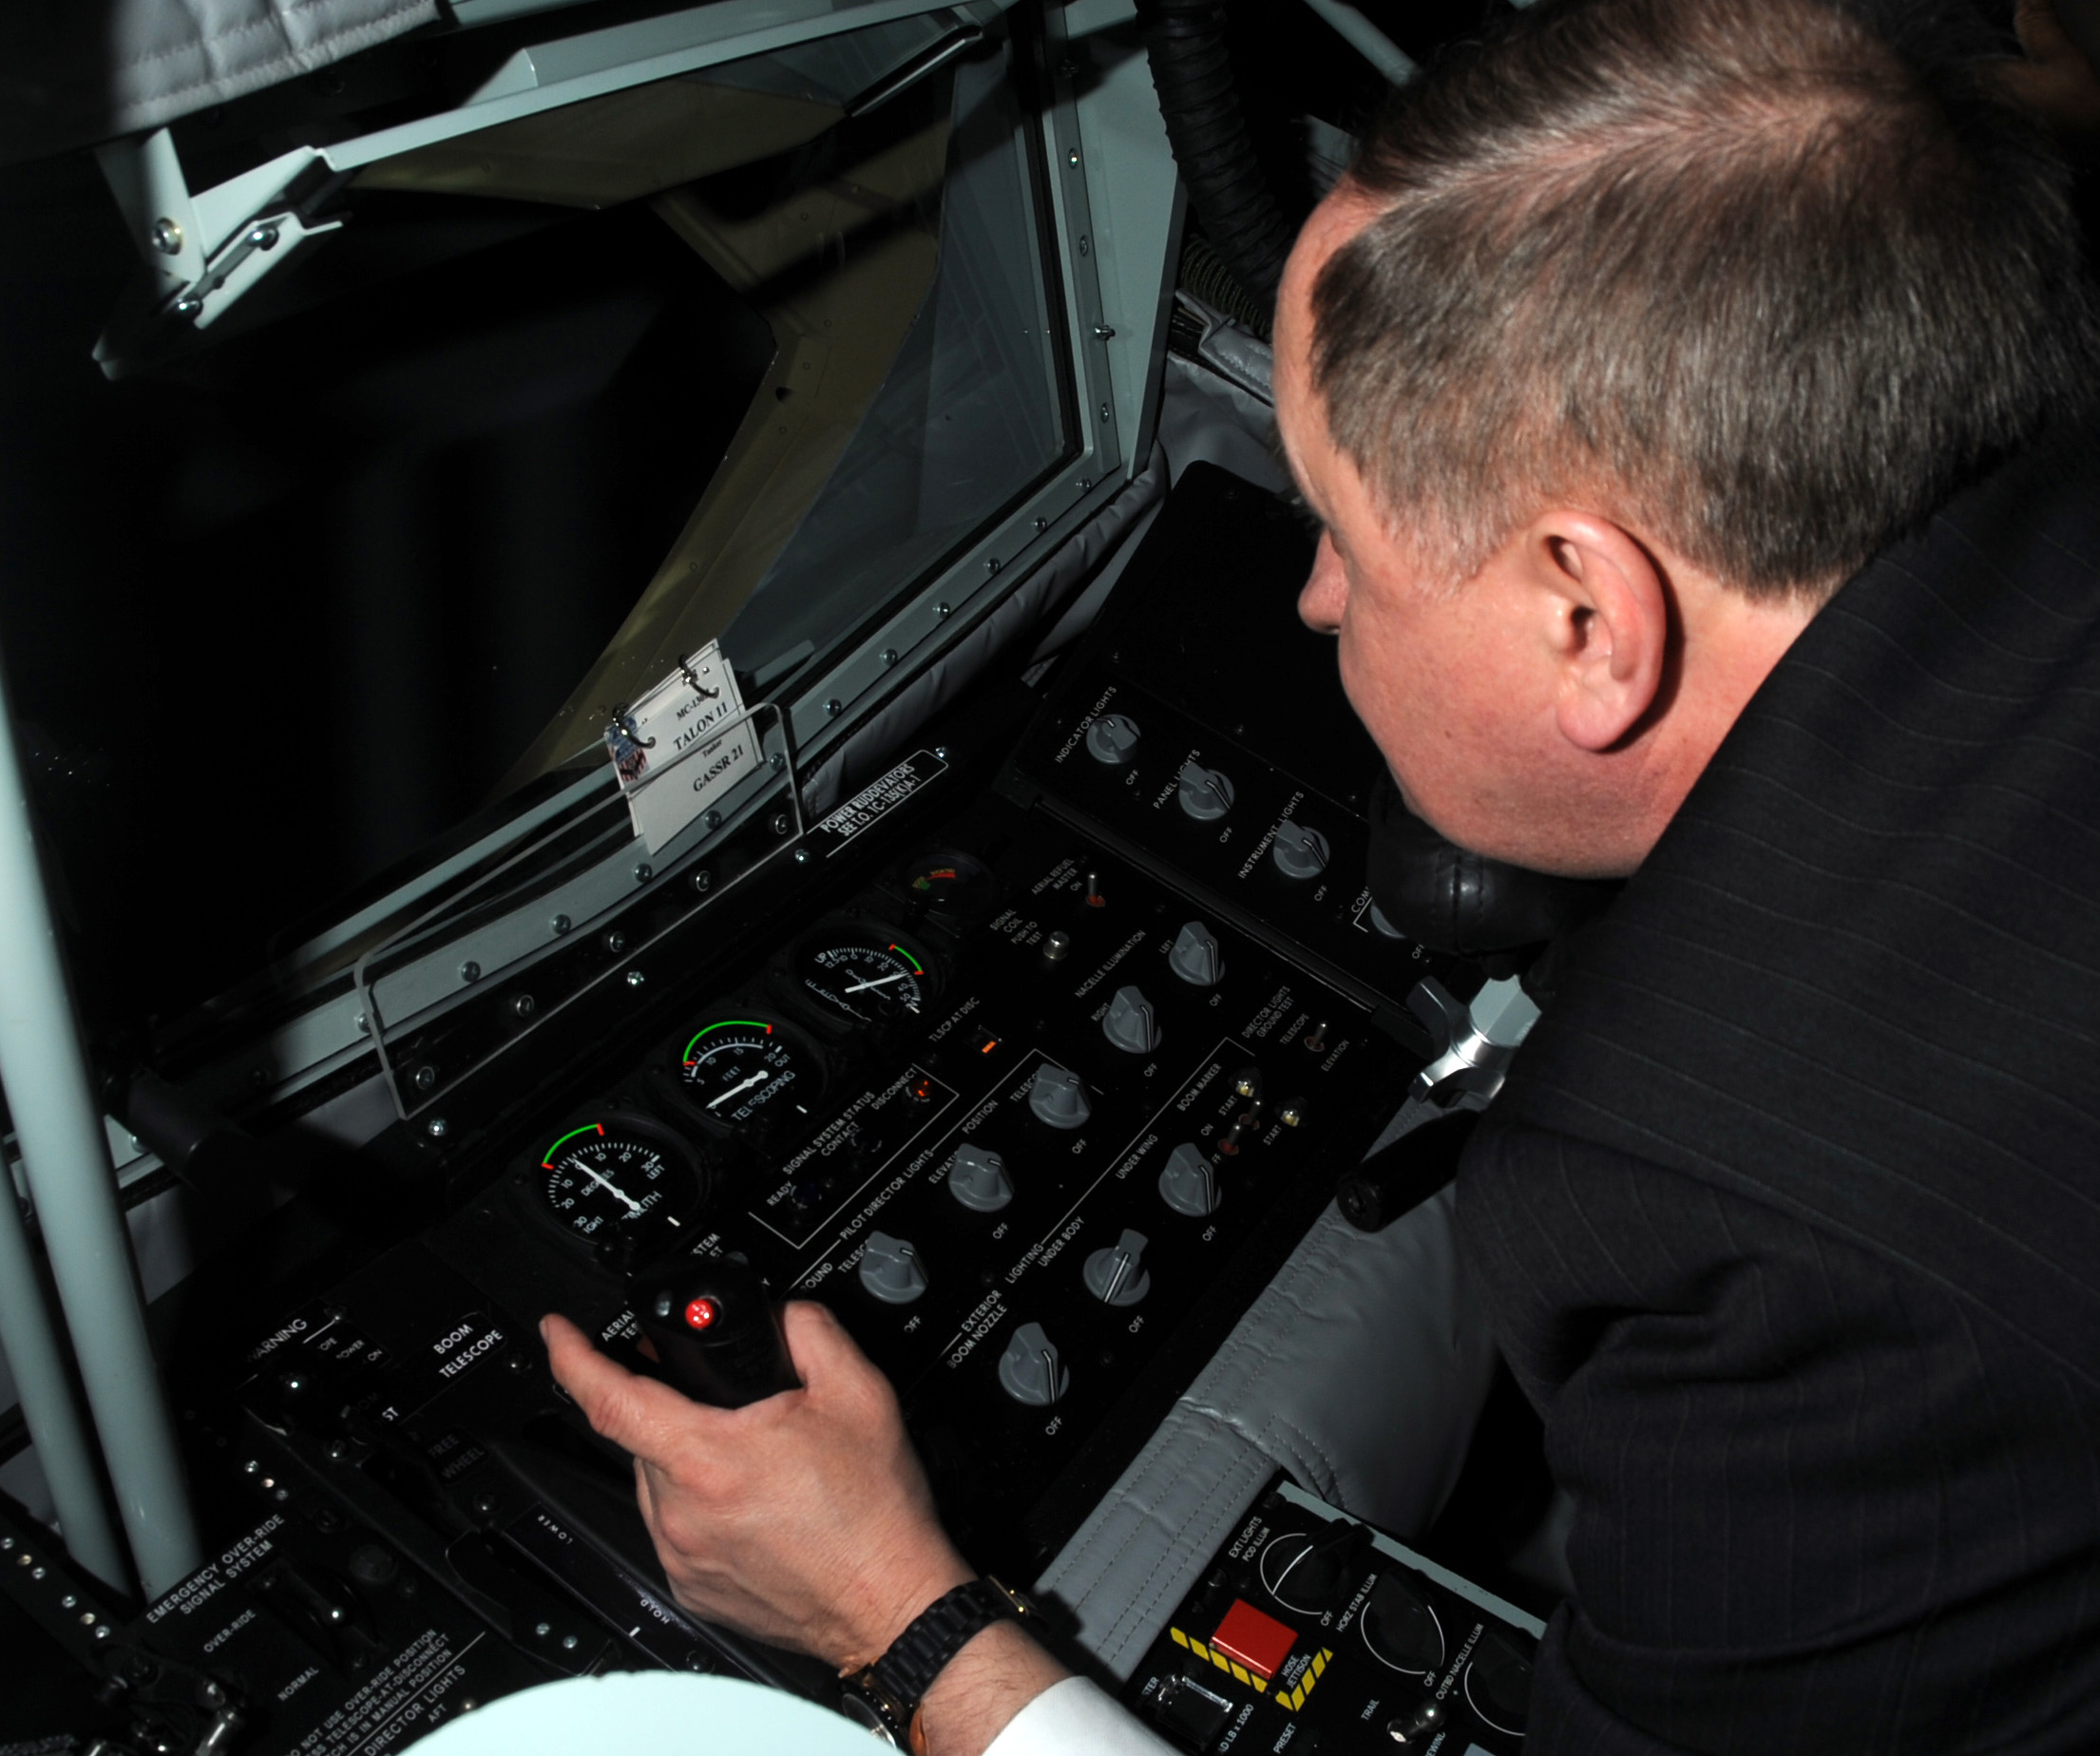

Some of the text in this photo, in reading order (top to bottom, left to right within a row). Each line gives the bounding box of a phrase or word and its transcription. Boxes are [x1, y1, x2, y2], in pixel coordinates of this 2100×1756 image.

[673, 702, 728, 752] TALON 11
[1054, 685, 1117, 764] INDICATOR LIGHTS
[702, 739, 722, 757] Tanker
[693, 744, 744, 792] GASSR 21
[1125, 769, 1140, 786] OFF
[819, 763, 915, 833] POWER RUDDEVATORS
[1153, 780, 1178, 811] PANEL
[836, 822, 858, 836] SEE
[1219, 826, 1234, 844] OFF
[1237, 791, 1305, 880] INSTRUMENT LIGHTS
[1052, 868, 1079, 890] MASTER
[1069, 881, 1083, 892] ON
[1313, 885, 1328, 902] OFF
[1350, 885, 1371, 914] COM
[989, 908, 1017, 931] SIGNAL
[1002, 917, 1023, 933] COIL
[1010, 921, 1038, 945] PUSH TO
[1025, 930, 1043, 945] TEST
[1158, 939, 1174, 955] LEFT
[813, 951, 827, 964] UP
[1074, 928, 1147, 999] NACELLE ILLUMINATION
[1090, 1002, 1111, 1022] RIGHT
[1209, 993, 1223, 1007] OFF
[1241, 985, 1291, 1039] DIRECTOR LIGHTS
[928, 996, 981, 1042] TLSCP AT DISC
[1255, 996, 1295, 1039] GROUND TEST
[1279, 1012, 1310, 1045] TELESCOPE
[774, 1053, 792, 1068] OUT
[1320, 1039, 1351, 1073] ELEVATION
[722, 1065, 742, 1082] FEET
[1143, 1062, 1159, 1078] OFF
[870, 1067, 918, 1111] DISCONNECT
[1176, 1062, 1223, 1113] BOOM MARKER
[962, 1099, 999, 1135] POSITION
[1218, 1095, 1238, 1117] START
[782, 1091, 876, 1175] SIGNAL SYSTEM STATUS
[821, 1120, 859, 1156] CONTACT
[1200, 1122, 1214, 1137] ON
[1263, 1124, 1283, 1147] START
[595, 1152, 607, 1162] 10
[619, 1152, 632, 1163] 20
[1071, 1138, 1088, 1155] OFF
[1115, 1133, 1159, 1180] UNDER WING
[1211, 1153, 1222, 1165] FF
[561, 1178, 574, 1188] 10
[646, 1163, 666, 1180] LEFT
[562, 1197, 575, 1210] 20
[766, 1180, 792, 1207] READY
[839, 1149, 934, 1241] PILOT DIRECTOR LIGHTS
[573, 1216, 587, 1228] 30
[582, 1215, 604, 1234] IGHT
[992, 1222, 1009, 1240] OFF
[1201, 1224, 1217, 1242] OFF
[1037, 1215, 1085, 1268] UNDER BODY
[837, 1239, 869, 1274] TELESC
[1004, 1242, 1045, 1285] LIGHTING
[904, 1314, 922, 1334] OFF
[961, 1289, 1002, 1332] EXTERIOR
[1128, 1314, 1146, 1334] OFF
[432, 1323, 474, 1355] BOOM
[946, 1303, 1008, 1369] BOOM NOZZLE
[438, 1328, 504, 1379] TELESCOPE
[1044, 1415, 1063, 1436] OFF
[428, 1433, 460, 1460] FREE
[440, 1447, 486, 1480] WHEEL
[1228, 1516, 1263, 1559] EXT LIGHTS
[1252, 1526, 1271, 1548] ILLUM
[145, 1513, 285, 1624] EMERGENCY OVER-RIDE
[180, 1539, 274, 1615] SIGNAL SYSTEM
[1349, 1593, 1366, 1615] STAB
[1362, 1573, 1378, 1596] ILLUM
[202, 1608, 257, 1653] OVER-RIDE
[1320, 1610, 1333, 1627] OFF
[1282, 1653, 1300, 1678] HOSE
[1286, 1652, 1312, 1689] JETTISON
[1435, 1623, 1485, 1701] OUTBD NACELLE ILLUM
[277, 1666, 319, 1703] NORMAL
[300, 1727, 323, 1749] NOT
[323, 1709, 346, 1729] USE
[344, 1666, 395, 1711] OVER-RIDE
[392, 1628, 437, 1668] POSITION
[325, 1632, 450, 1744] TELESCOPE-AT-DISCONNECT
[1140, 1676, 1160, 1696] STER
[1423, 1670, 1437, 1688] OFF
[346, 1648, 453, 1744] IS IN MANUAL POSITION
[363, 1664, 467, 1756] DIRECTOR LIGHTS
[427, 1703, 449, 1724] AFT
[1227, 1729, 1237, 1743] LB
[1236, 1703, 1255, 1727] 1000
[1360, 1698, 1380, 1722] TRAIL
[1272, 1722, 1297, 1755] PRESET
